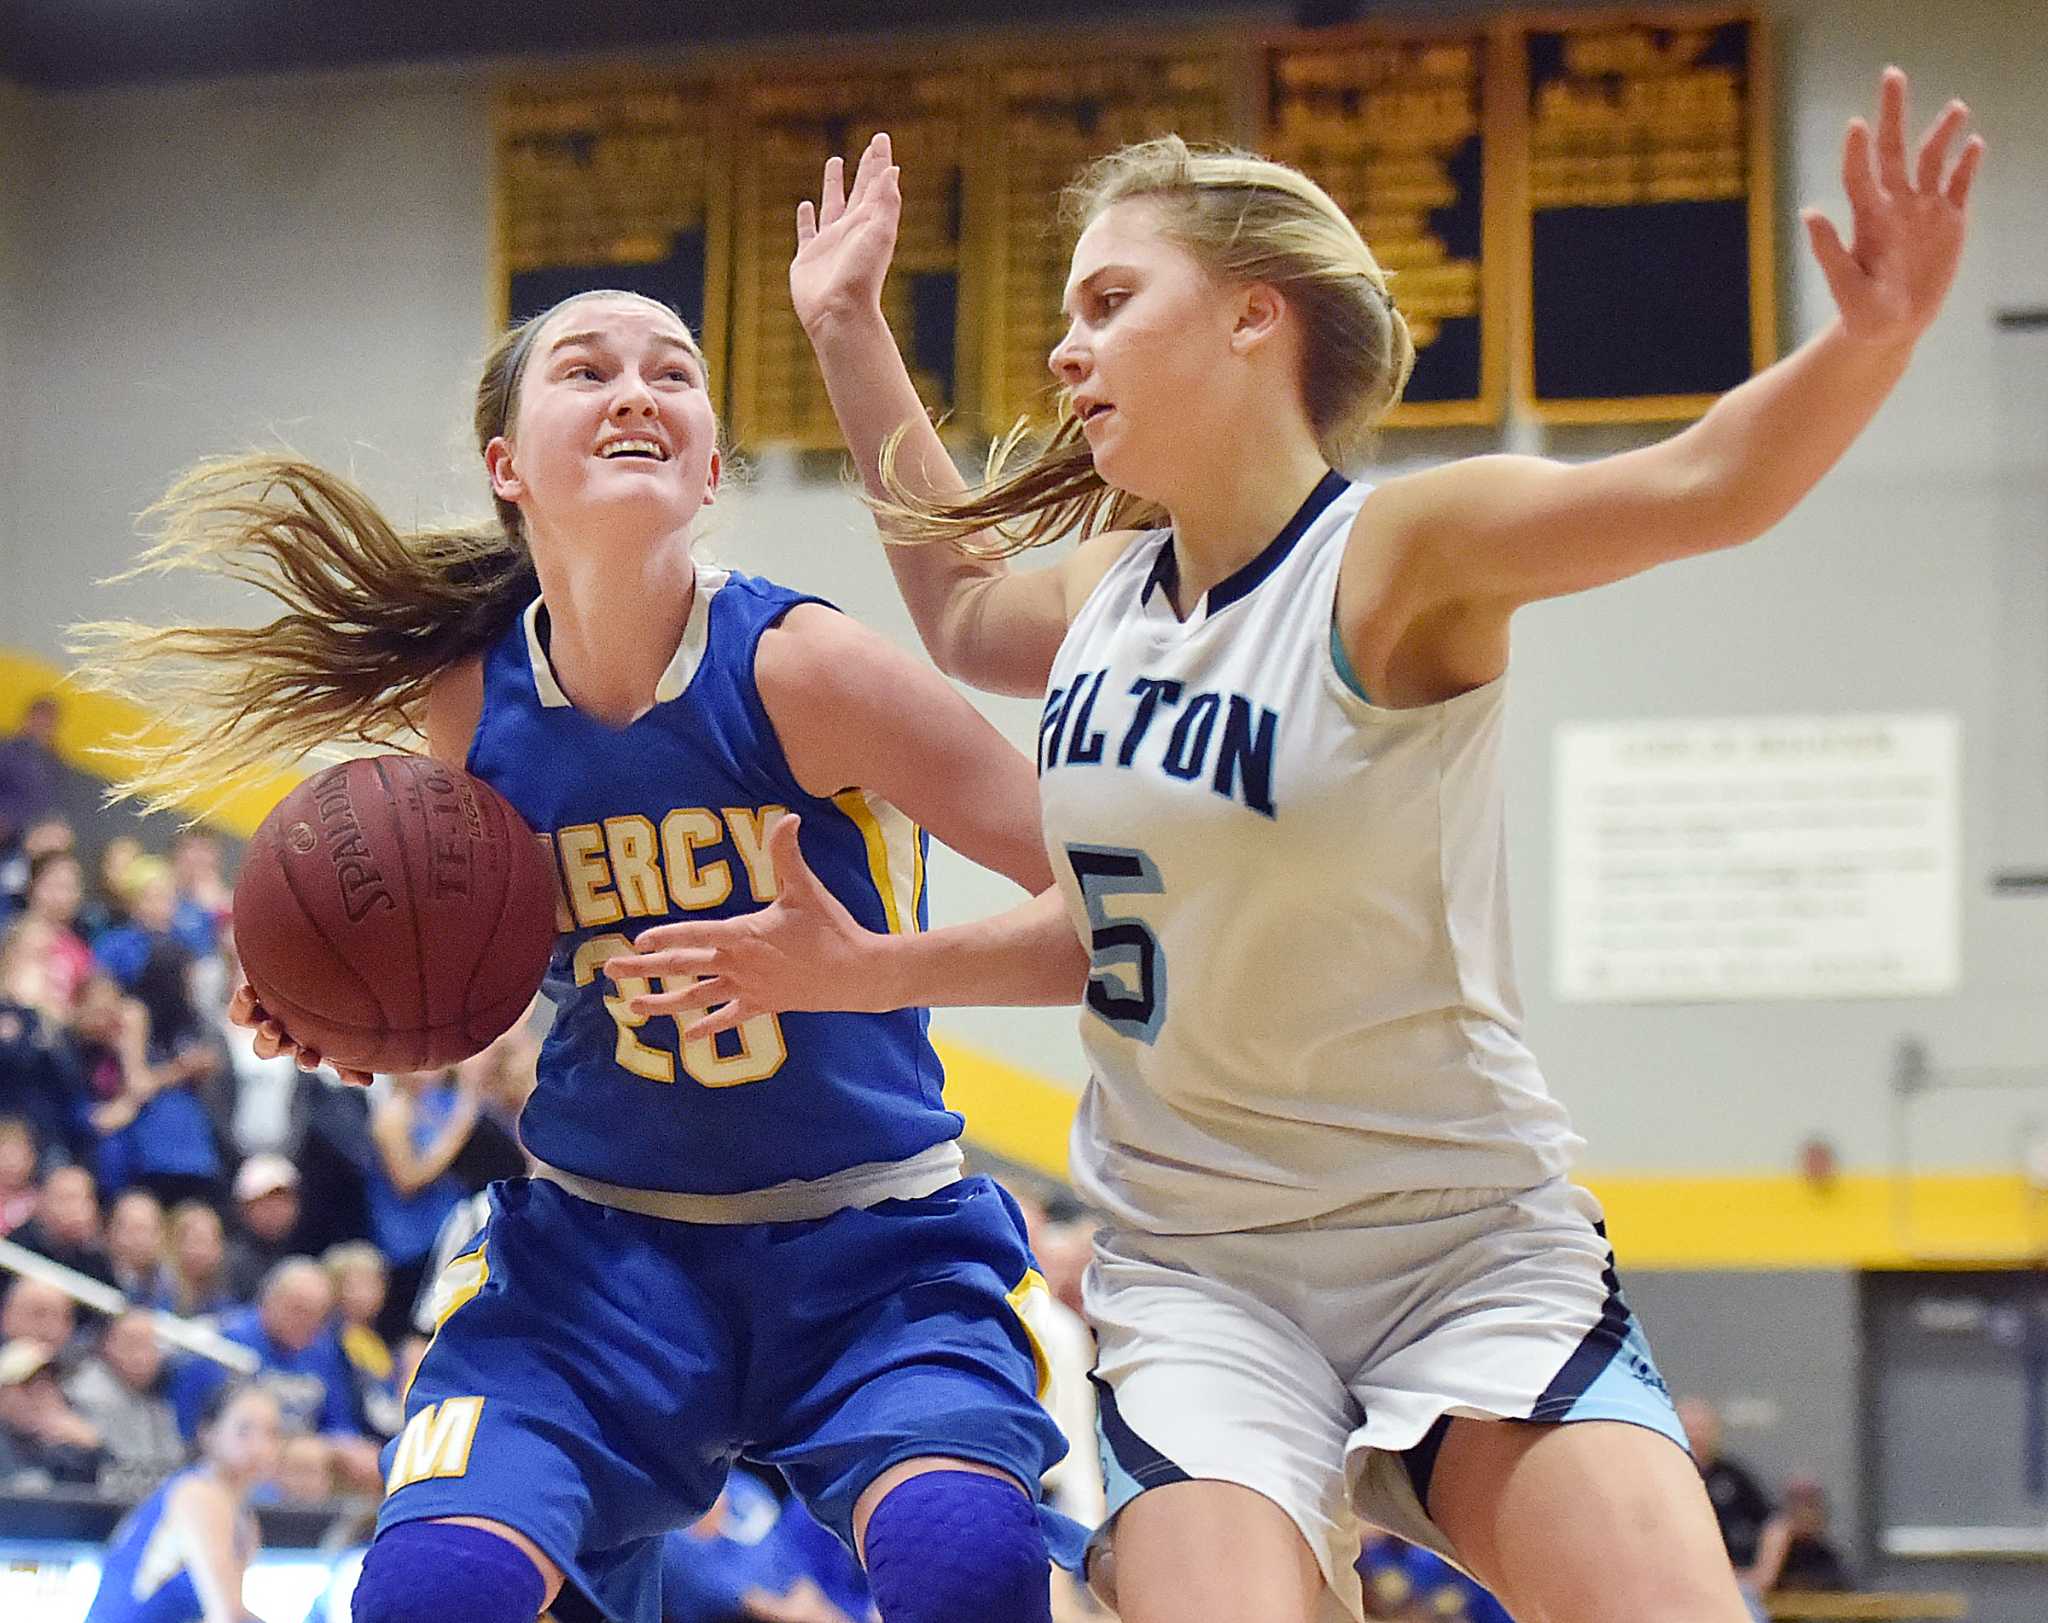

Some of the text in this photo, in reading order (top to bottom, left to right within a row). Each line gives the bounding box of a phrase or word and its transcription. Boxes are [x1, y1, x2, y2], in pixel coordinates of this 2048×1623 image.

[312, 766, 397, 925] SPALDI
[535, 804, 790, 933] ERCY
[1063, 841, 1168, 1047] 5
[386, 1395, 485, 1497] M
